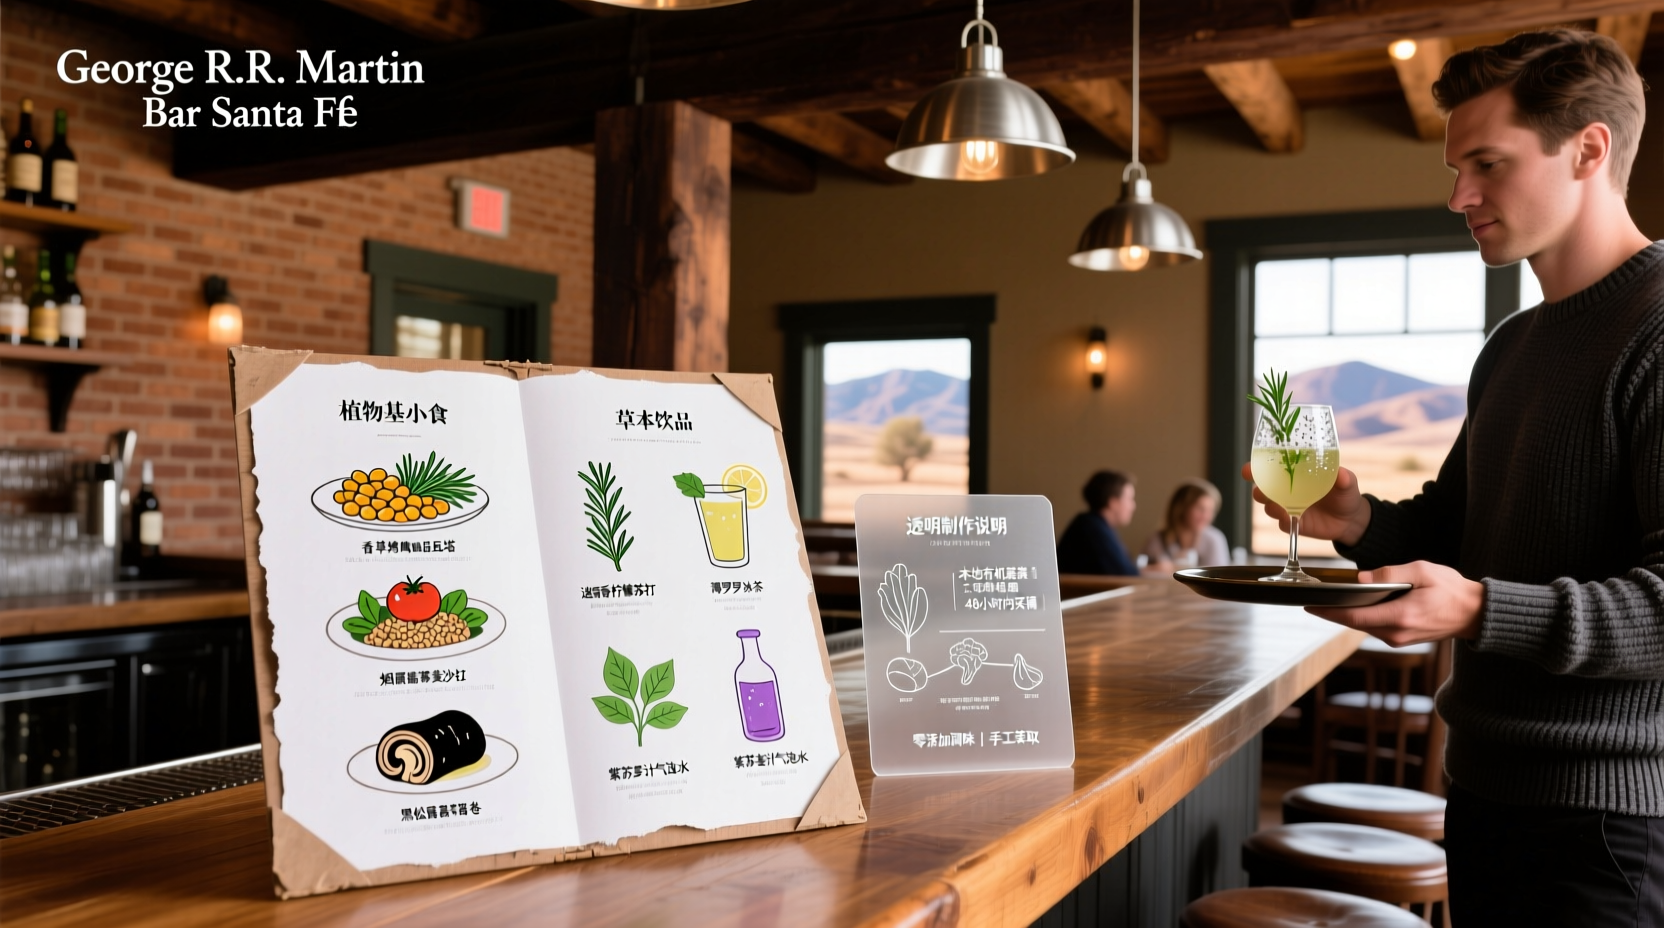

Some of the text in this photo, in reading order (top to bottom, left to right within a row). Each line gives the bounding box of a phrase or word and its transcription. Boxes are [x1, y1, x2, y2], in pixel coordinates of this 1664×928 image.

[338, 399, 449, 425] 植物基小食
[615, 408, 693, 432] 草本饮品
[905, 515, 1008, 536] 透明制作说明
